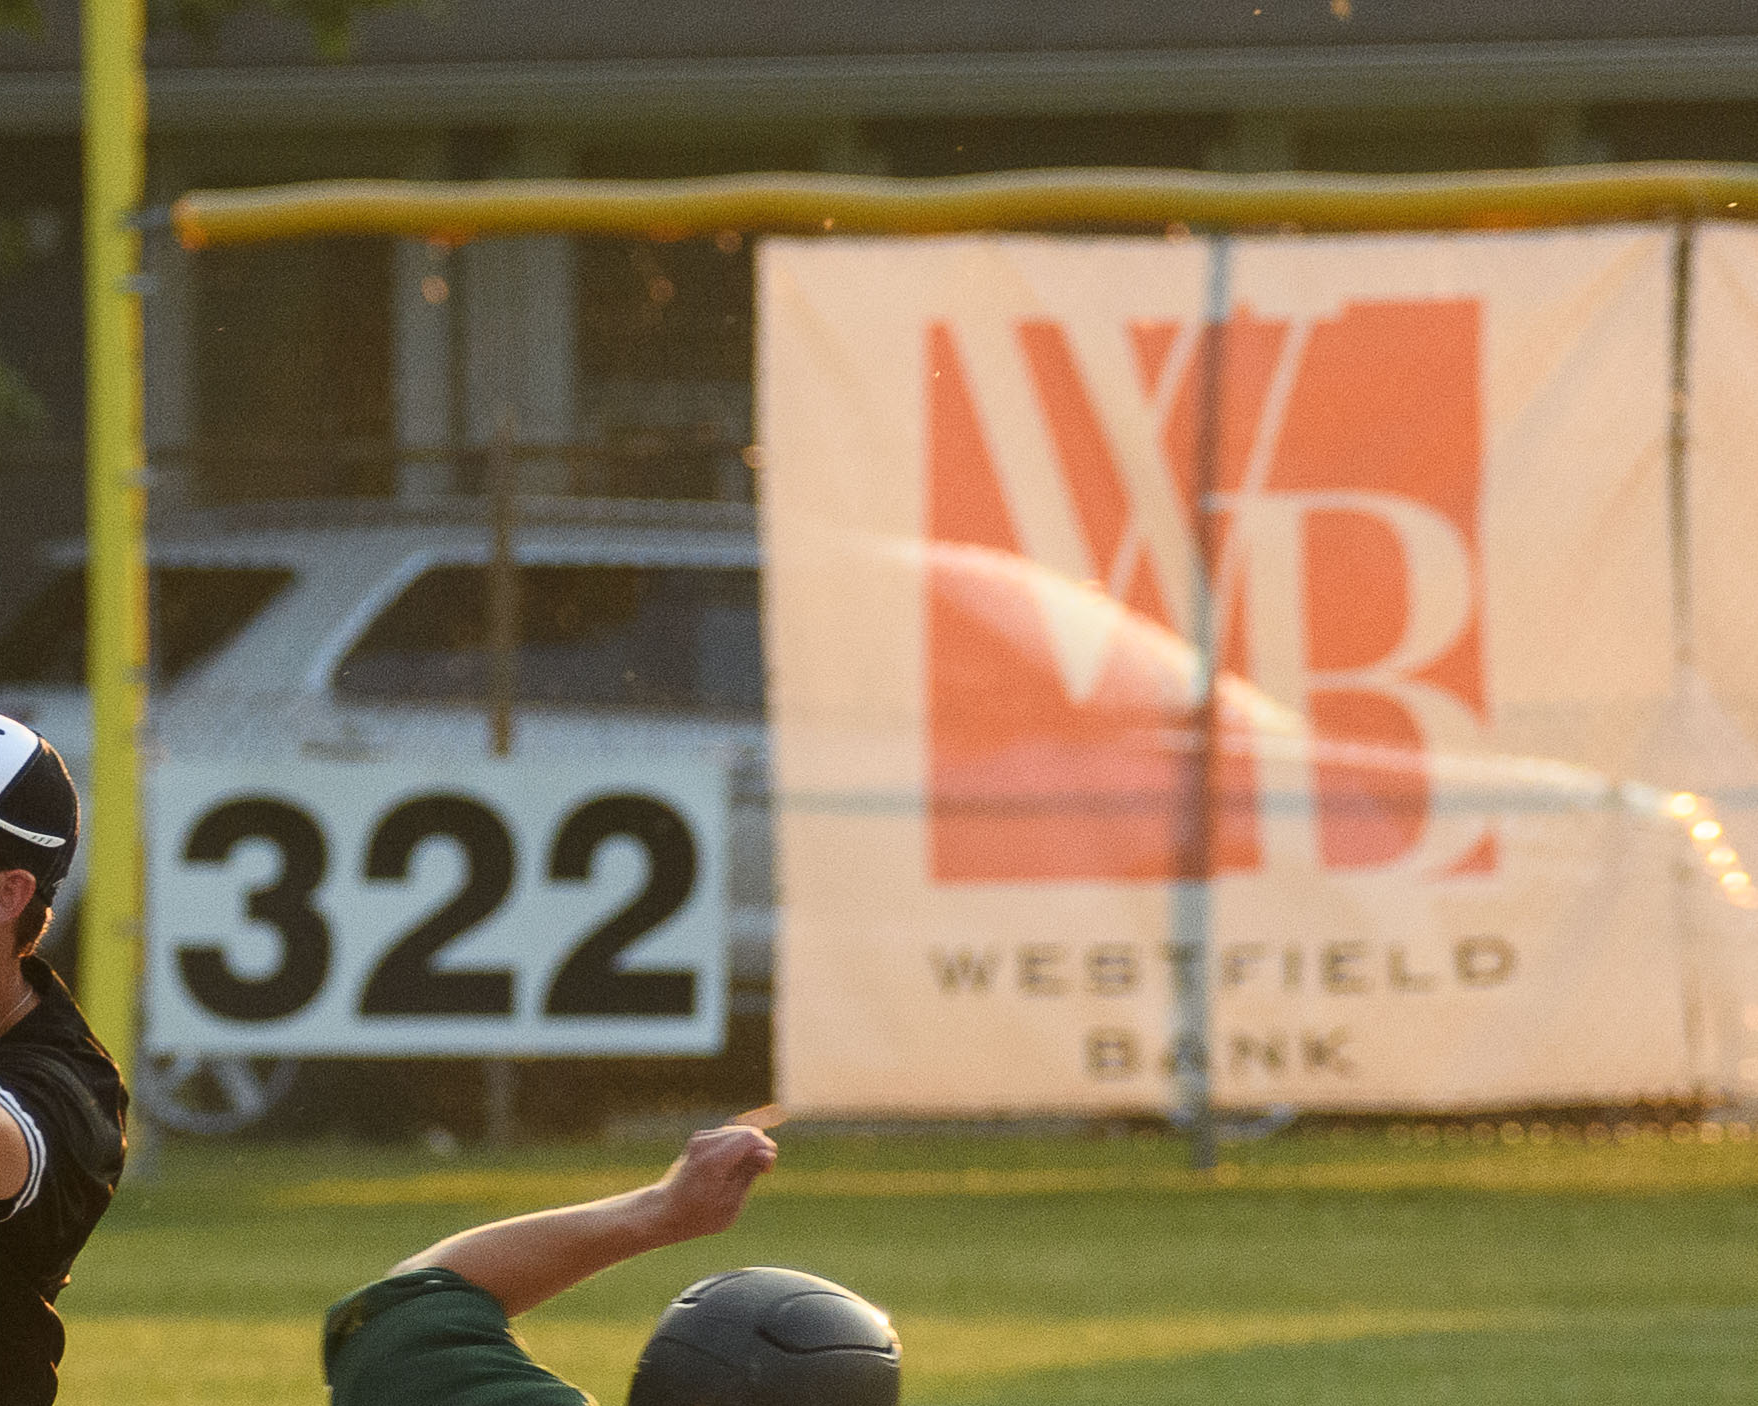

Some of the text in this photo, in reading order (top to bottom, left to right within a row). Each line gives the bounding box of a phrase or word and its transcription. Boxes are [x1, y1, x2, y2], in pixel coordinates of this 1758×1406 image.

[176, 788, 698, 1022] 322
[929, 936, 1518, 999] WESTFIELD
[1083, 1025, 1356, 1081] BANK
